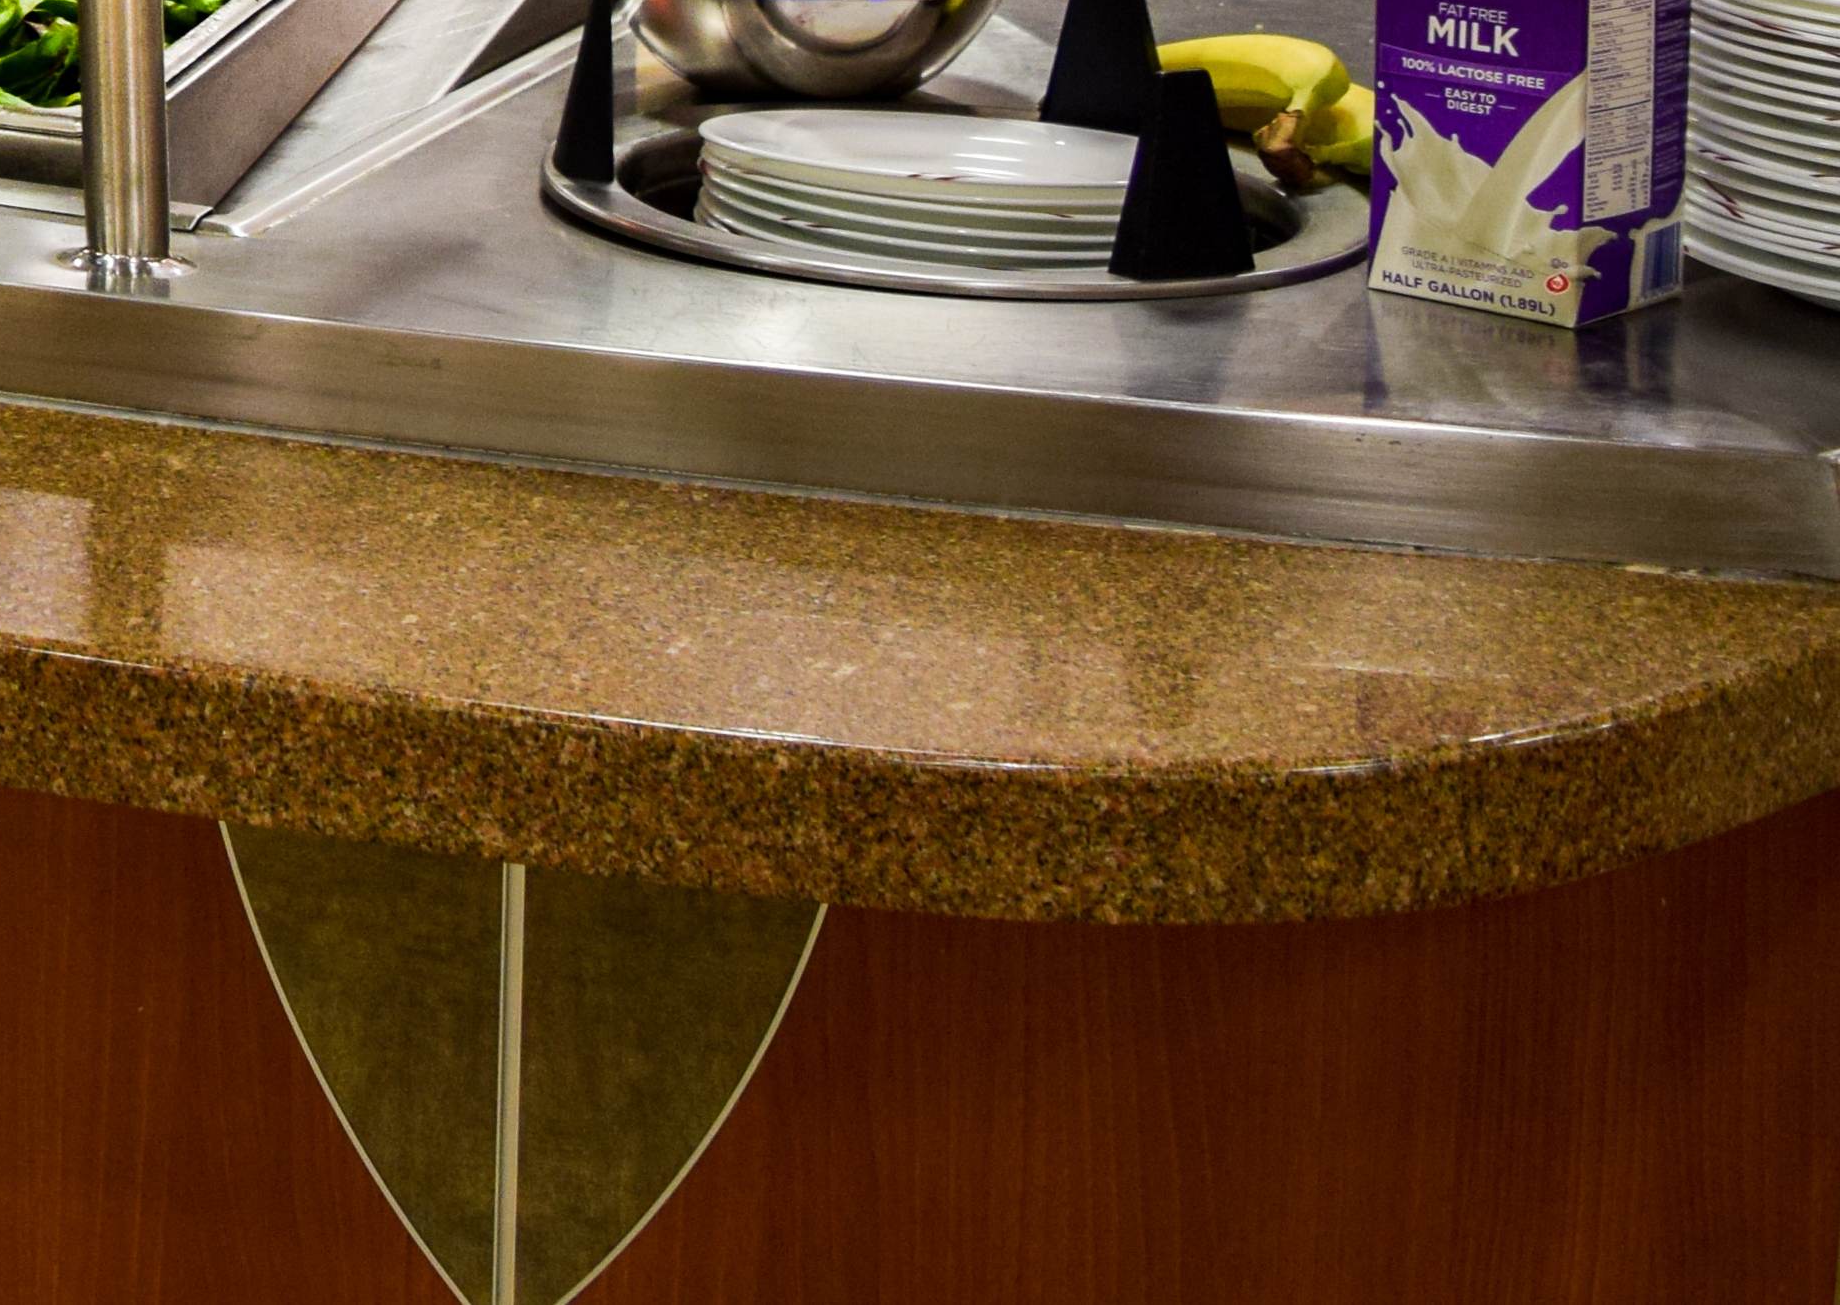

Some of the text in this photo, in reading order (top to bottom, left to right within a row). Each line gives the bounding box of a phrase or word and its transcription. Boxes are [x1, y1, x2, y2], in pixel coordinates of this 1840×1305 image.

[1438, 2, 1508, 25] FAT FREE
[1427, 15, 1520, 57] MILK
[1401, 56, 1545, 90] 100% LACTOSE FREE
[1444, 87, 1496, 105] EASY TO
[1447, 99, 1493, 115] DIGEST
[1401, 246, 1439, 262] GRADE
[1454, 257, 1508, 275] VITAMINS
[1411, 261, 1523, 289] ULTRA-PASTEURIZED
[1382, 270, 1556, 317] HALF GALLON (1.89L)
